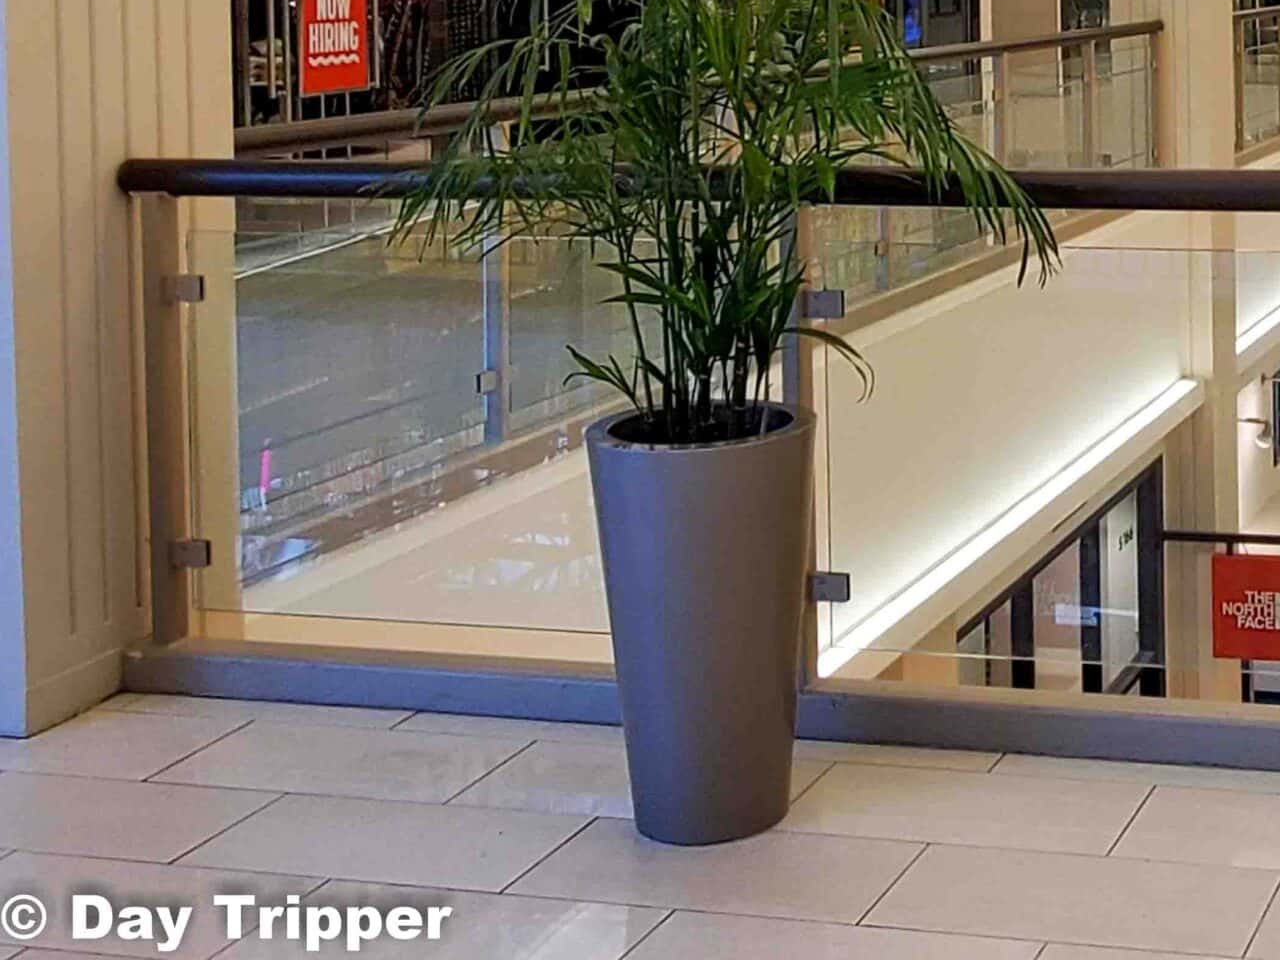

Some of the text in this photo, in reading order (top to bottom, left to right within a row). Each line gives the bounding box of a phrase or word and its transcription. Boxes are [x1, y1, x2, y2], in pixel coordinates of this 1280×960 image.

[308, 20, 360, 54] HIRING
[1245, 590, 1274, 604] THE
[1222, 602, 1274, 618] NORTH
[1237, 616, 1275, 630] FACE
